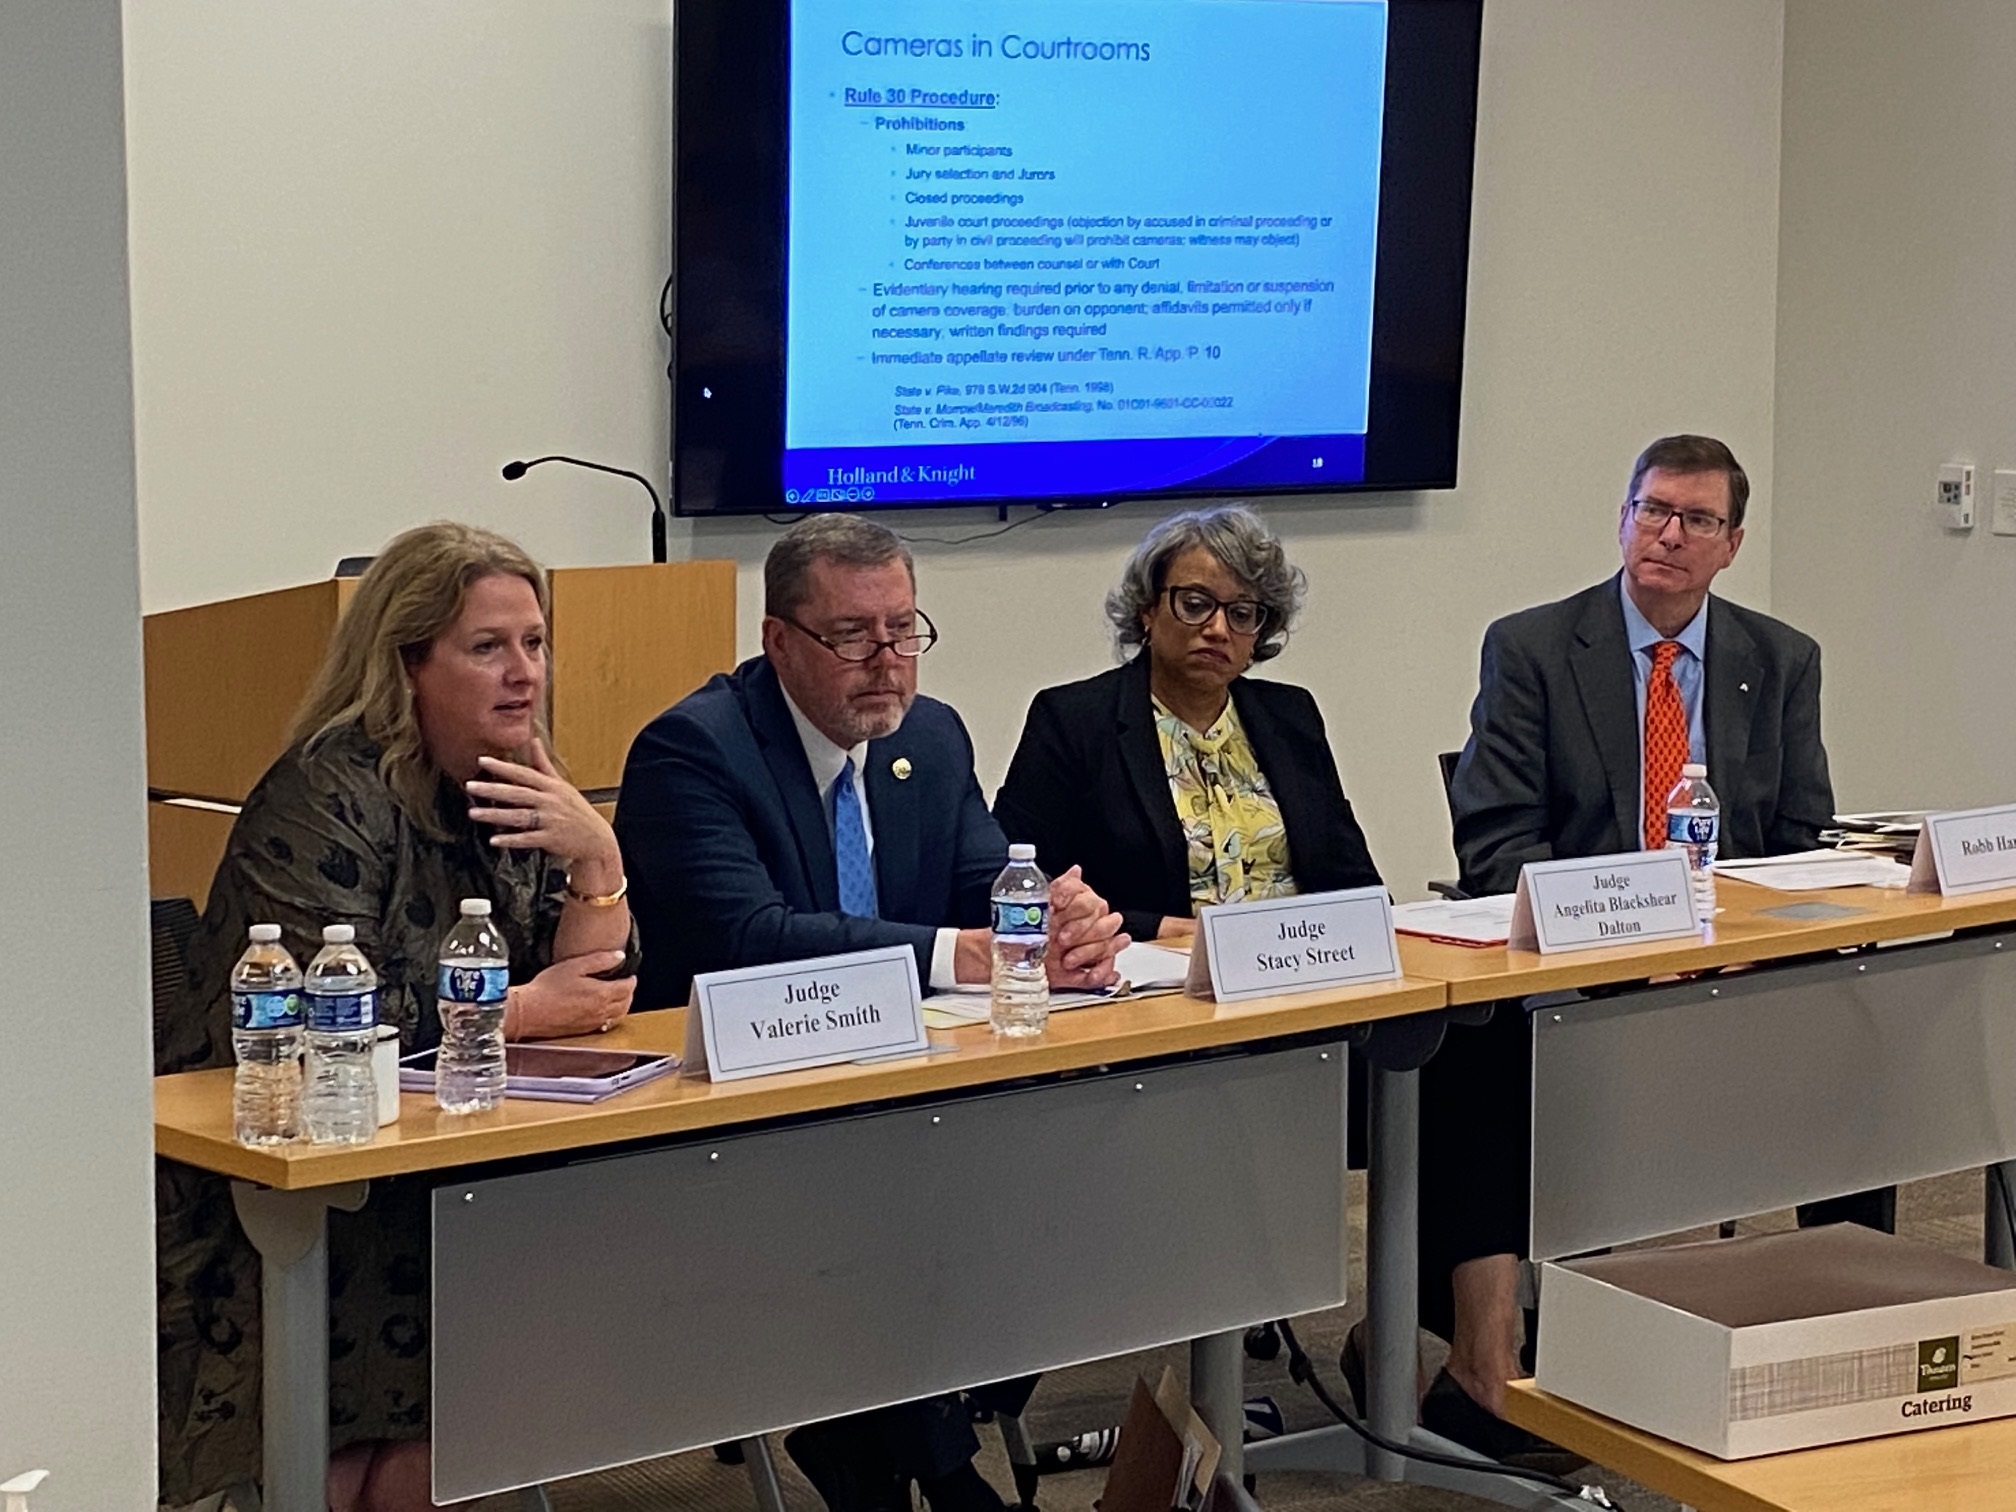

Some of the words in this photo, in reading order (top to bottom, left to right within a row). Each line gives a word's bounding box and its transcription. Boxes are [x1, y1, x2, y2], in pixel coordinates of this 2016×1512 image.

[842, 30, 963, 57] Cameras
[972, 33, 993, 57] in
[1001, 34, 1150, 61] Courtrooms
[844, 87, 881, 104] Rule
[886, 88, 906, 104] 30
[911, 88, 1000, 106] Procedure:
[875, 116, 965, 132] Prohibitions
[906, 143, 941, 156] Minor
[943, 144, 1013, 158] participants
[905, 167, 931, 181] Jury
[935, 168, 989, 180] selection
[992, 168, 1015, 180] and
[1018, 168, 1056, 180] Jurors
[905, 192, 947, 204] Closed
[951, 192, 1024, 207] proceedings
[905, 216, 955, 228] Juvenile
[958, 216, 988, 227] court
[991, 216, 1064, 230] proceedings
[1067, 216, 1123, 230] (objection
[1127, 216, 1141, 230] by
[1144, 216, 1192, 227] accused
[1195, 216, 1206, 227] in
[1208, 215, 1253, 227] criminal
[1255, 215, 1317, 230] proceeding
[1320, 217, 1332, 227] or
[905, 235, 919, 249] by
[922, 236, 953, 249] party
[957, 235, 967, 246] in
[970, 234, 993, 246] civil
[996, 234, 1062, 249] proceeding
[1065, 234, 1084, 246] will
[1087, 234, 1130, 248] prohibit
[1189, 234, 1231, 246] witness
[1235, 235, 1258, 248] may
[1261, 233, 1300, 248] object)
[904, 258, 980, 271] Conferences
[984, 258, 1034, 270] between
[1037, 258, 1083, 269] counsel
[1086, 260, 1098, 269] or
[1101, 257, 1124, 269] with
[1128, 257, 1160, 270] Court
[873, 283, 948, 298] Evidentiary
[952, 282, 1002, 298] hearing
[1006, 282, 1061, 298] required
[1065, 282, 1094, 297] prior
[1097, 282, 1111, 294] to
[1114, 283, 1138, 297] any
[1141, 281, 1183, 294] denial,
[1187, 280, 1244, 294] limitation
[1247, 282, 1260, 293] or
[1263, 279, 1334, 295] suspension
[872, 304, 886, 317] of
[889, 305, 940, 317] camera
[1013, 303, 1060, 316] burden
[1063, 304, 1081, 316] on
[1084, 302, 1149, 317] opponent;
[1152, 300, 1209, 314] affidavits
[1212, 299, 1271, 315] permitted
[1274, 299, 1300, 315] only
[1303, 299, 1312, 312] if
[949, 324, 994, 337] written
[998, 323, 1049, 339] findings
[1053, 322, 1106, 338] required
[872, 350, 942, 364] Immediate
[946, 349, 1008, 366] appellate
[1011, 350, 1054, 362] review
[1058, 348, 1095, 361] under
[1099, 347, 1133, 361] Tenn.
[1138, 347, 1152, 360] R.
[1205, 345, 1221, 360] 10
[895, 385, 922, 397] State
[1050, 382, 1080, 395] (Tenn.
[895, 404, 921, 416] State
[893, 418, 925, 431] (Tenn.
[929, 417, 956, 429] Crim.
[828, 466, 898, 485] Holland
[900, 466, 915, 483] &
[917, 463, 976, 487] Knight
[1961, 840, 1994, 857] Robb
[1593, 873, 1630, 891] Judge
[1554, 901, 1606, 920] Angelita
[1609, 893, 1677, 912] Blackshear
[1278, 920, 1326, 941] Judge
[1598, 919, 1641, 936] Dalton
[1256, 953, 1301, 973] Stacy
[1305, 945, 1355, 966] Street
[784, 980, 841, 1005] Judge
[750, 1013, 821, 1040] Valerie
[826, 1004, 881, 1031] Smith
[1901, 1394, 1972, 1417] Catering
